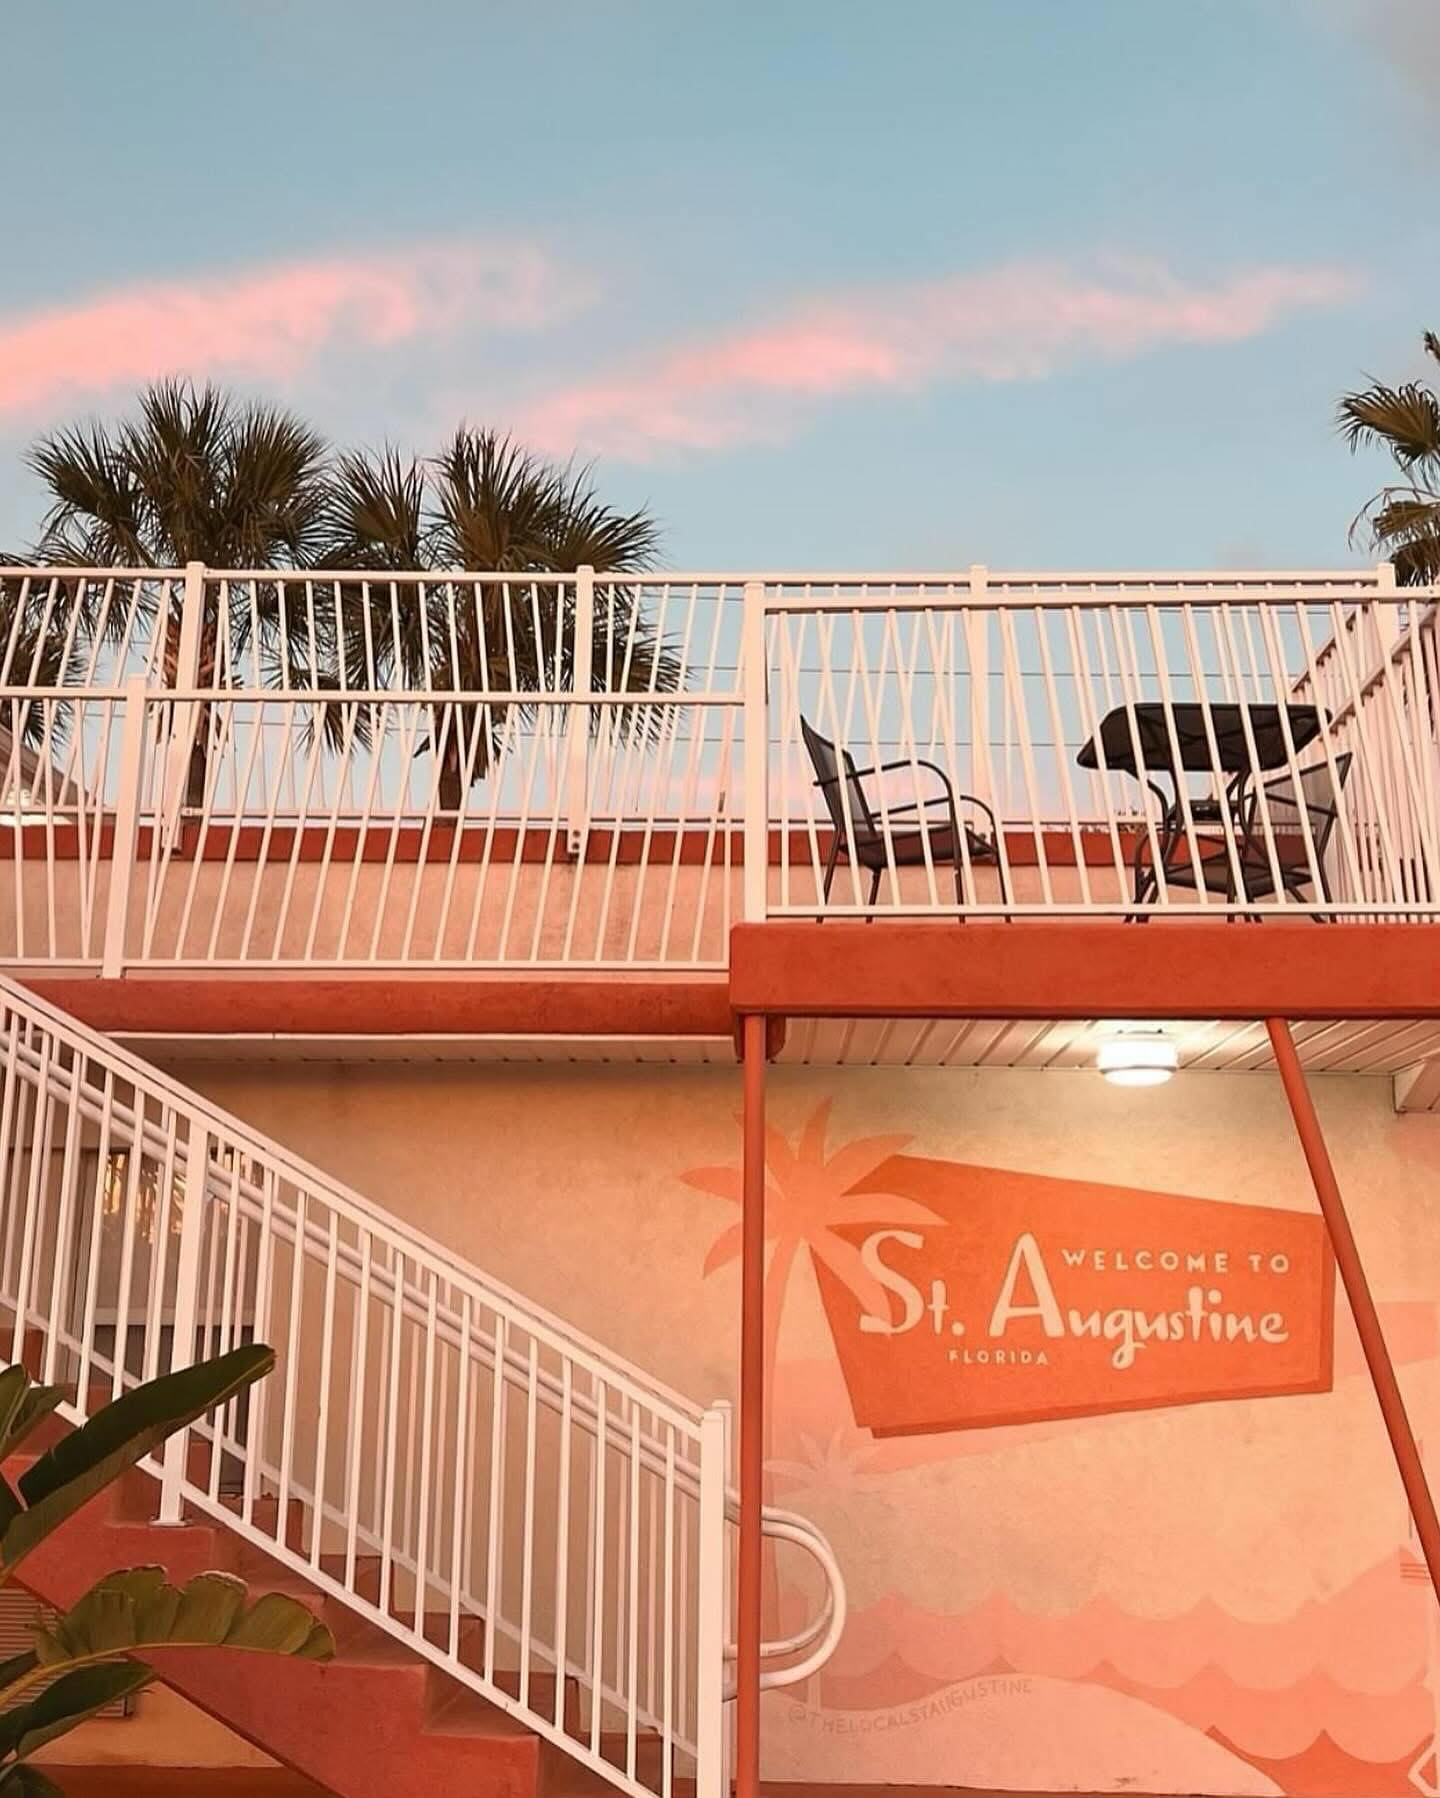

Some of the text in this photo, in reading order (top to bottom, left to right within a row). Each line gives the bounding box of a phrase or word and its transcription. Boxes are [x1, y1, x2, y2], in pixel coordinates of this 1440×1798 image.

[1062, 1249, 1290, 1274] WELCOME TO
[859, 1230, 1289, 1370] St. Augustine
[949, 1349, 1049, 1366] FLORIDA
